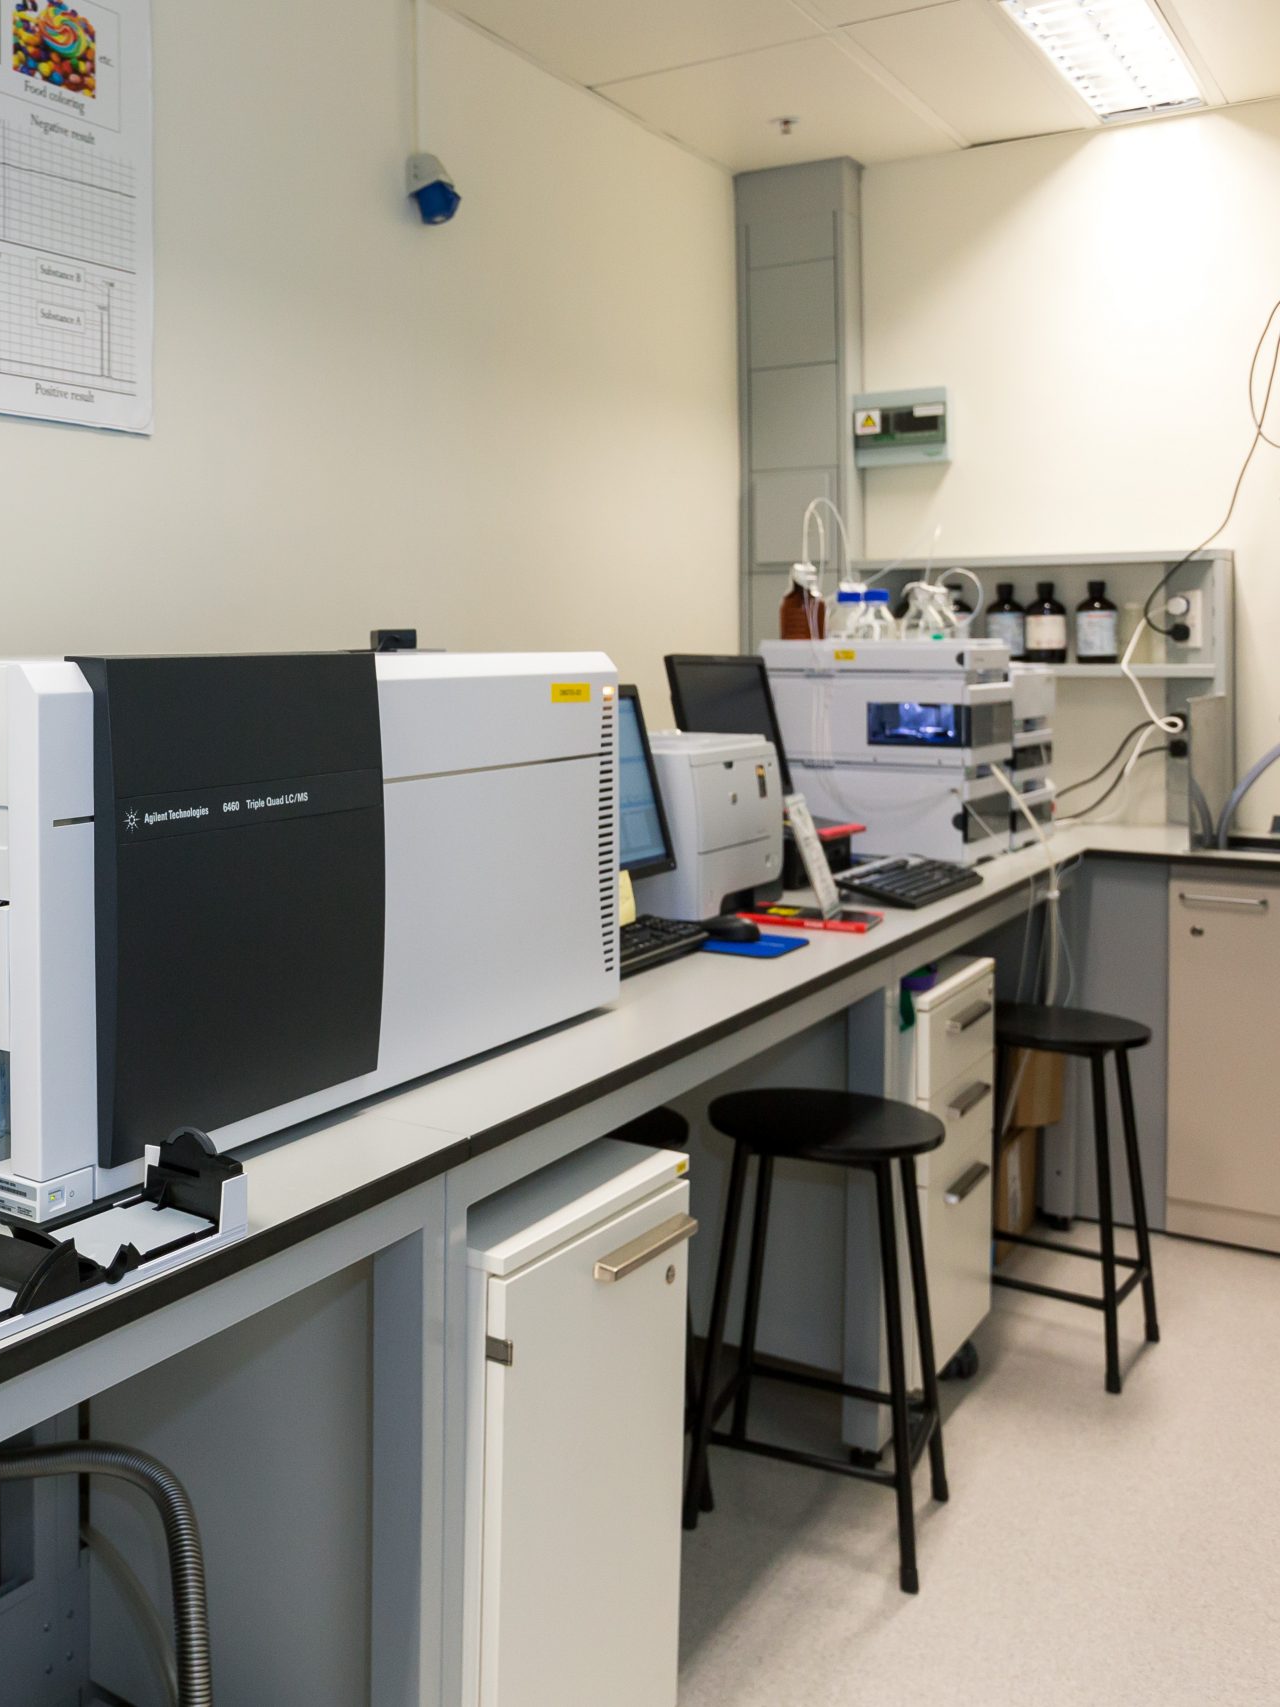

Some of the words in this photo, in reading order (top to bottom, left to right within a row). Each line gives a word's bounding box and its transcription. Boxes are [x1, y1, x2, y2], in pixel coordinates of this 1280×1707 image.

[24, 80, 47, 98] Food
[48, 89, 85, 115] coloring
[30, 114, 69, 135] Negative
[71, 130, 95, 145] result
[40, 264, 73, 282] Substance
[40, 308, 73, 325] Substance
[35, 383, 69, 400] Positive
[70, 389, 94, 403] result
[144, 810, 168, 825] Agilent
[168, 806, 209, 820] Technologies
[223, 801, 240, 813] 6460
[246, 799, 265, 811] Triple
[266, 795, 284, 807] Quad
[285, 791, 308, 804] LC/MS
